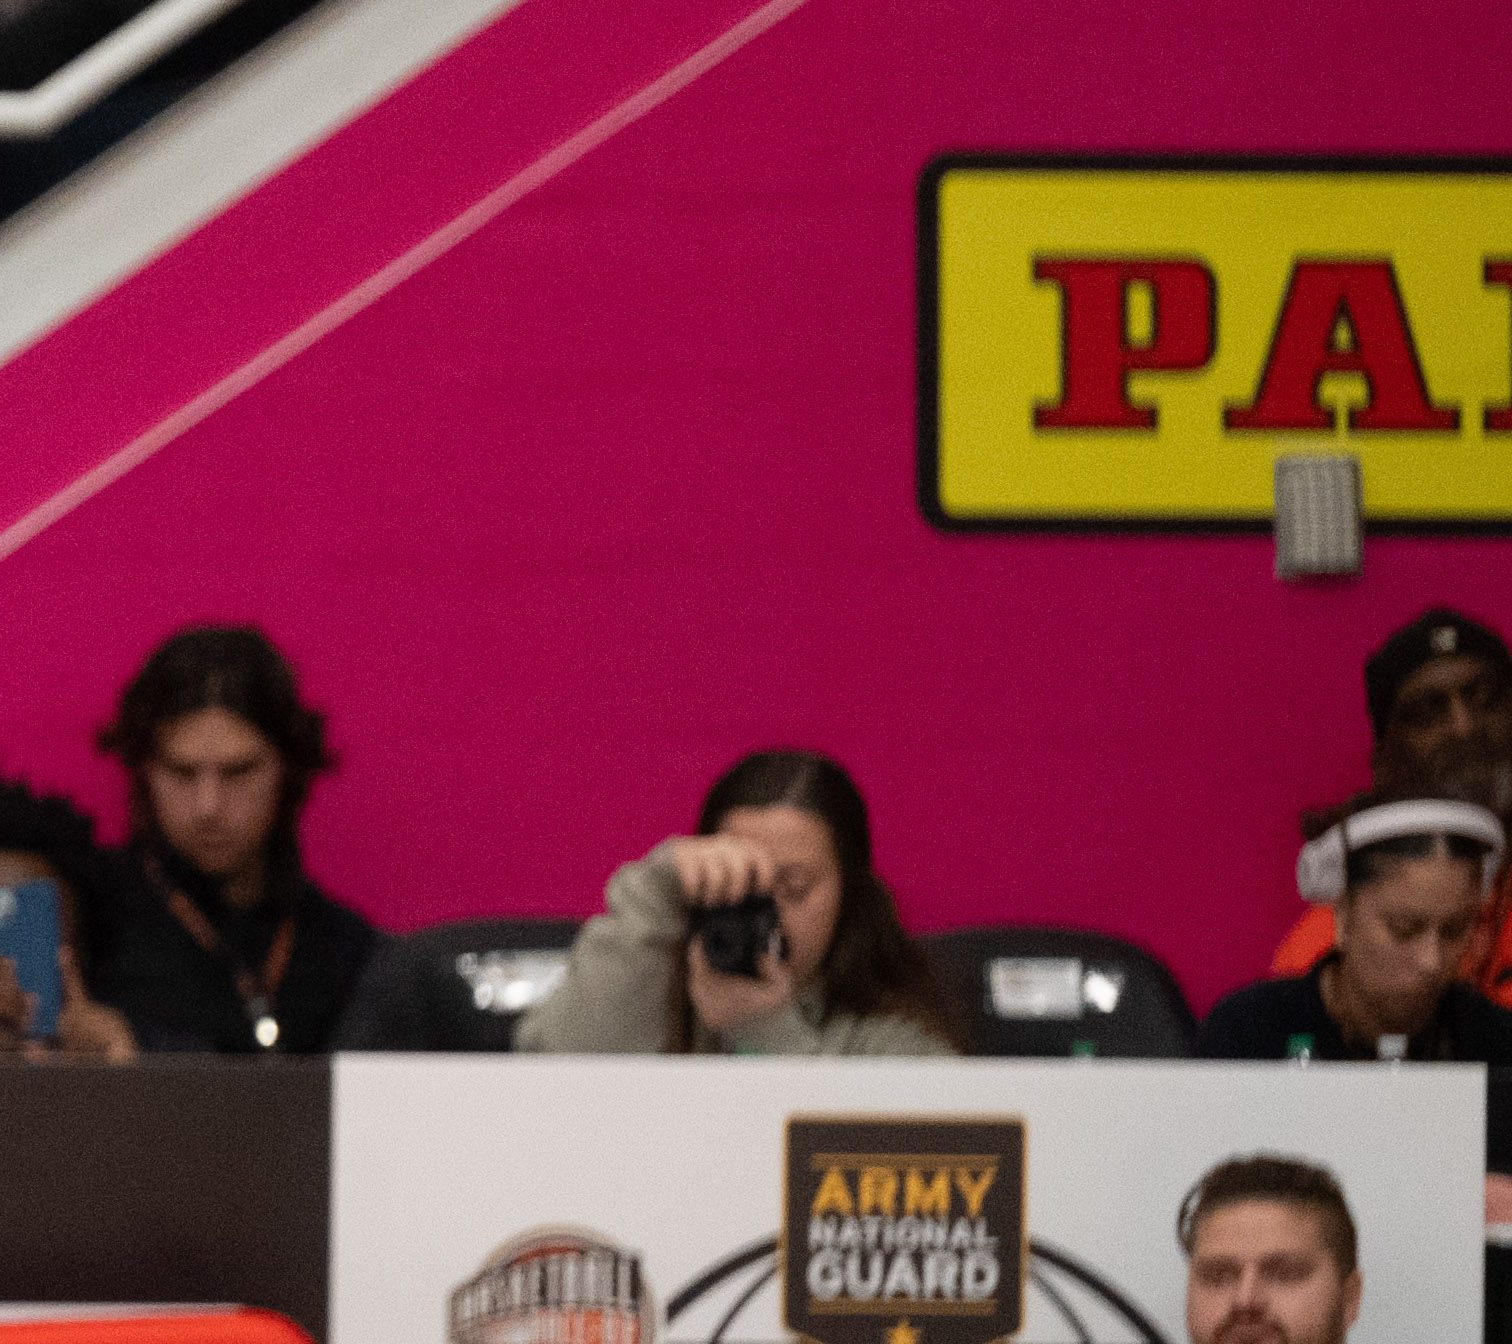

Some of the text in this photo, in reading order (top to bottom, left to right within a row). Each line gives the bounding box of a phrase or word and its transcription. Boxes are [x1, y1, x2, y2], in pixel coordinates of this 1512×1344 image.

[1030, 250, 1512, 434] PA
[811, 1166, 998, 1218] ARMY
[806, 1215, 1000, 1251] NATIONAL
[805, 1247, 1001, 1303] GUARD
